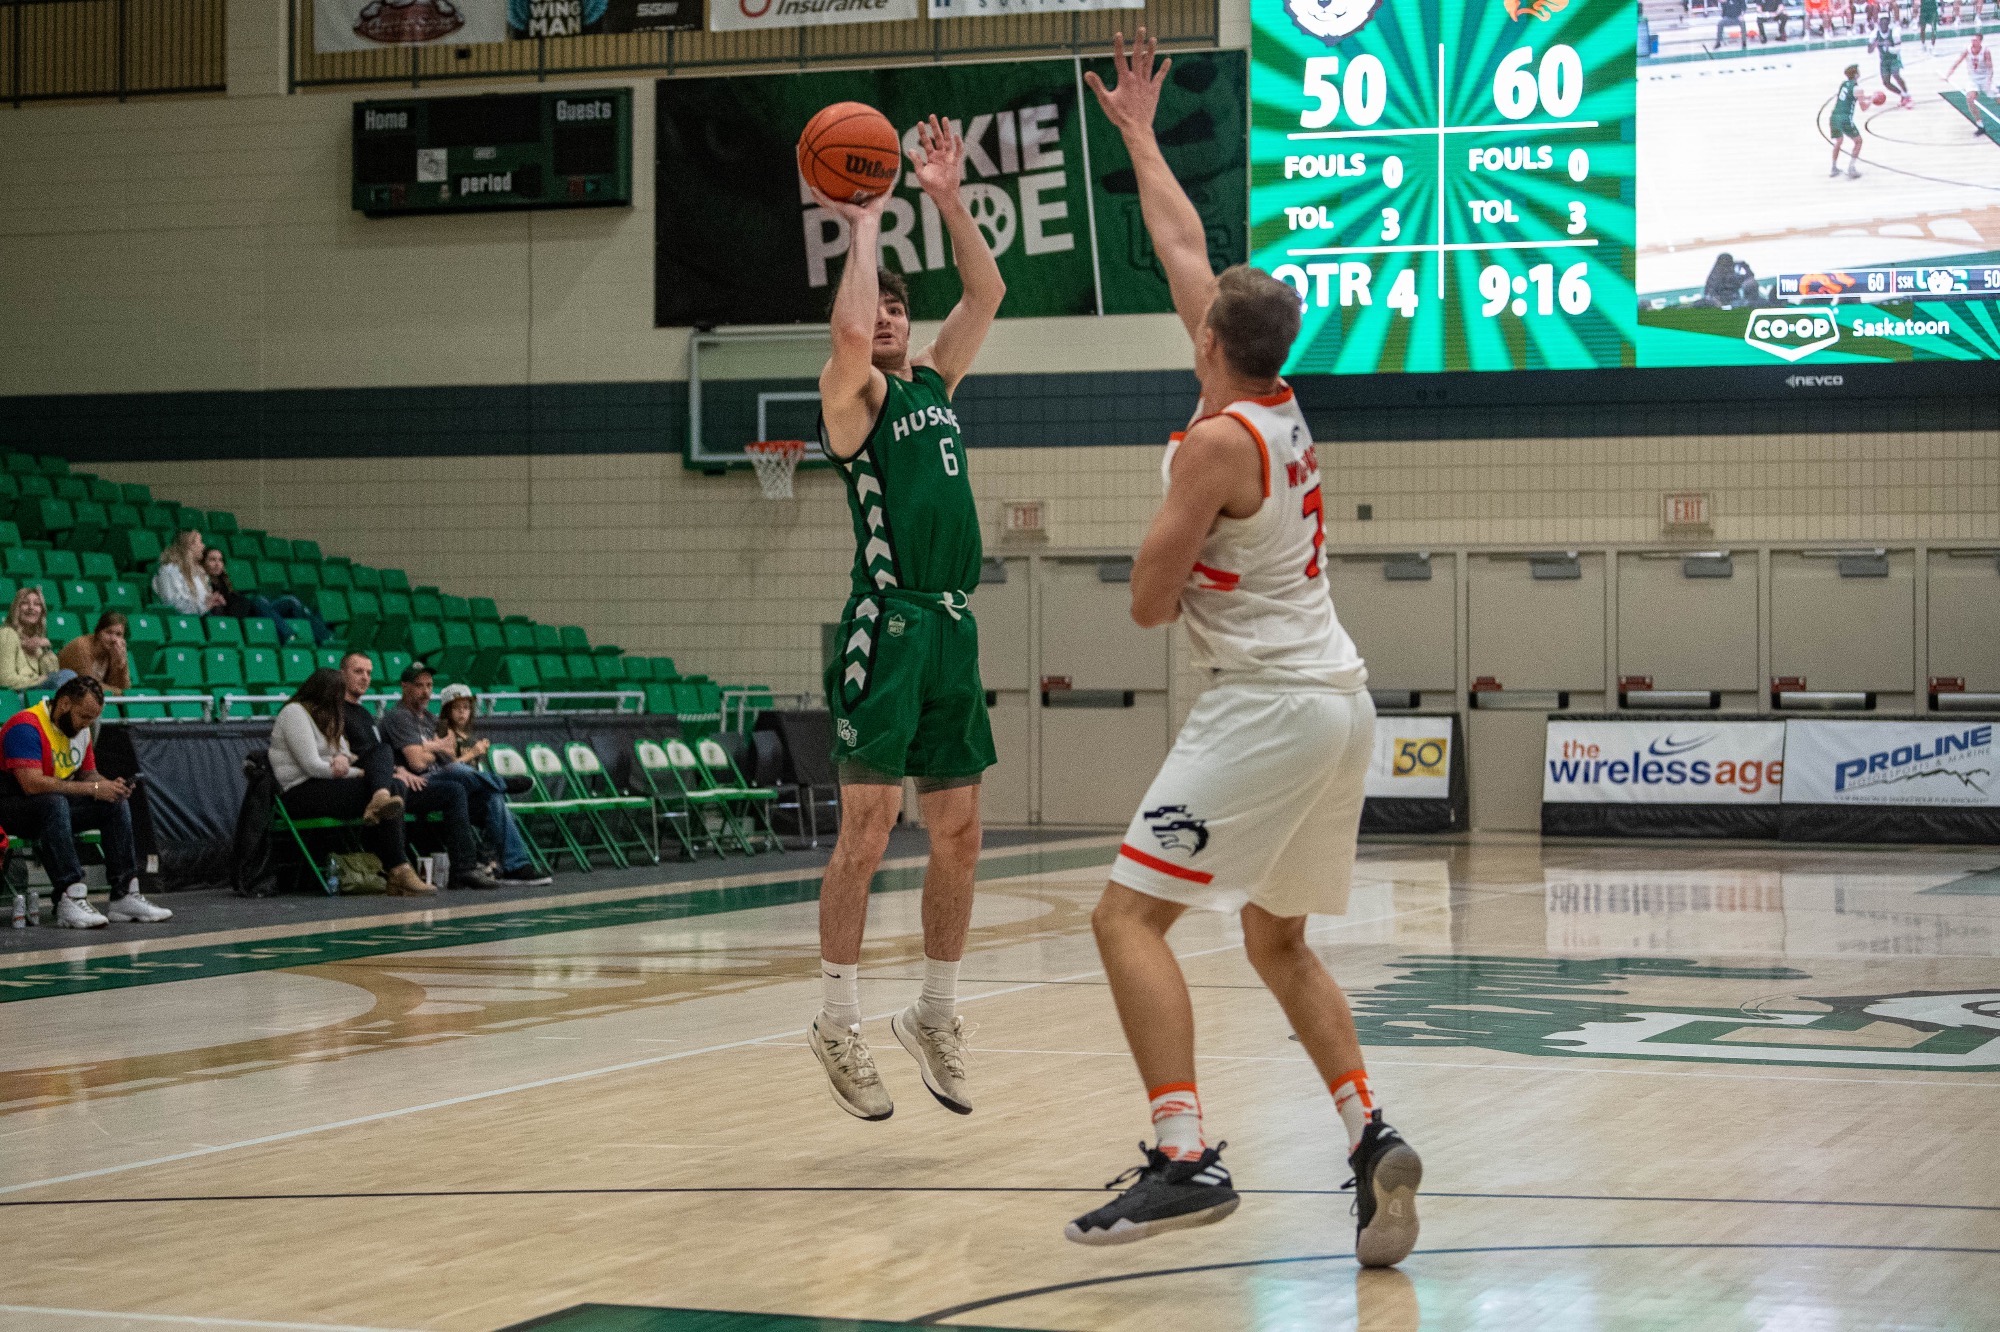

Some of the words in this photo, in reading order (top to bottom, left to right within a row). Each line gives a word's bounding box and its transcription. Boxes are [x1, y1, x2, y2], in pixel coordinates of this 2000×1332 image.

[528, 16, 581, 37] MAN
[529, 1, 581, 18] WING
[1300, 53, 1387, 129] 50
[1493, 44, 1584, 120] 60
[364, 109, 408, 131] Home
[556, 100, 612, 121] Guests
[1284, 153, 1366, 180] FOULS
[1382, 156, 1404, 189] 0
[1468, 146, 1554, 172] FOULS
[1568, 148, 1590, 182] 0
[461, 171, 512, 197] period
[1284, 206, 1334, 231] TOL
[1381, 208, 1401, 241] 3
[1468, 200, 1519, 225] TOL
[1567, 201, 1588, 235] 3
[1270, 262, 1373, 315] QTR
[1387, 269, 1419, 318] 4
[1478, 262, 1592, 318] 9:16
[1868, 273, 1885, 292] 60
[1852, 317, 1950, 337] Saskatoon
[939, 437, 959, 476] 6
[1397, 742, 1442, 774] 50
[1562, 740, 1600, 759] the
[1835, 725, 1992, 792] PROLINE
